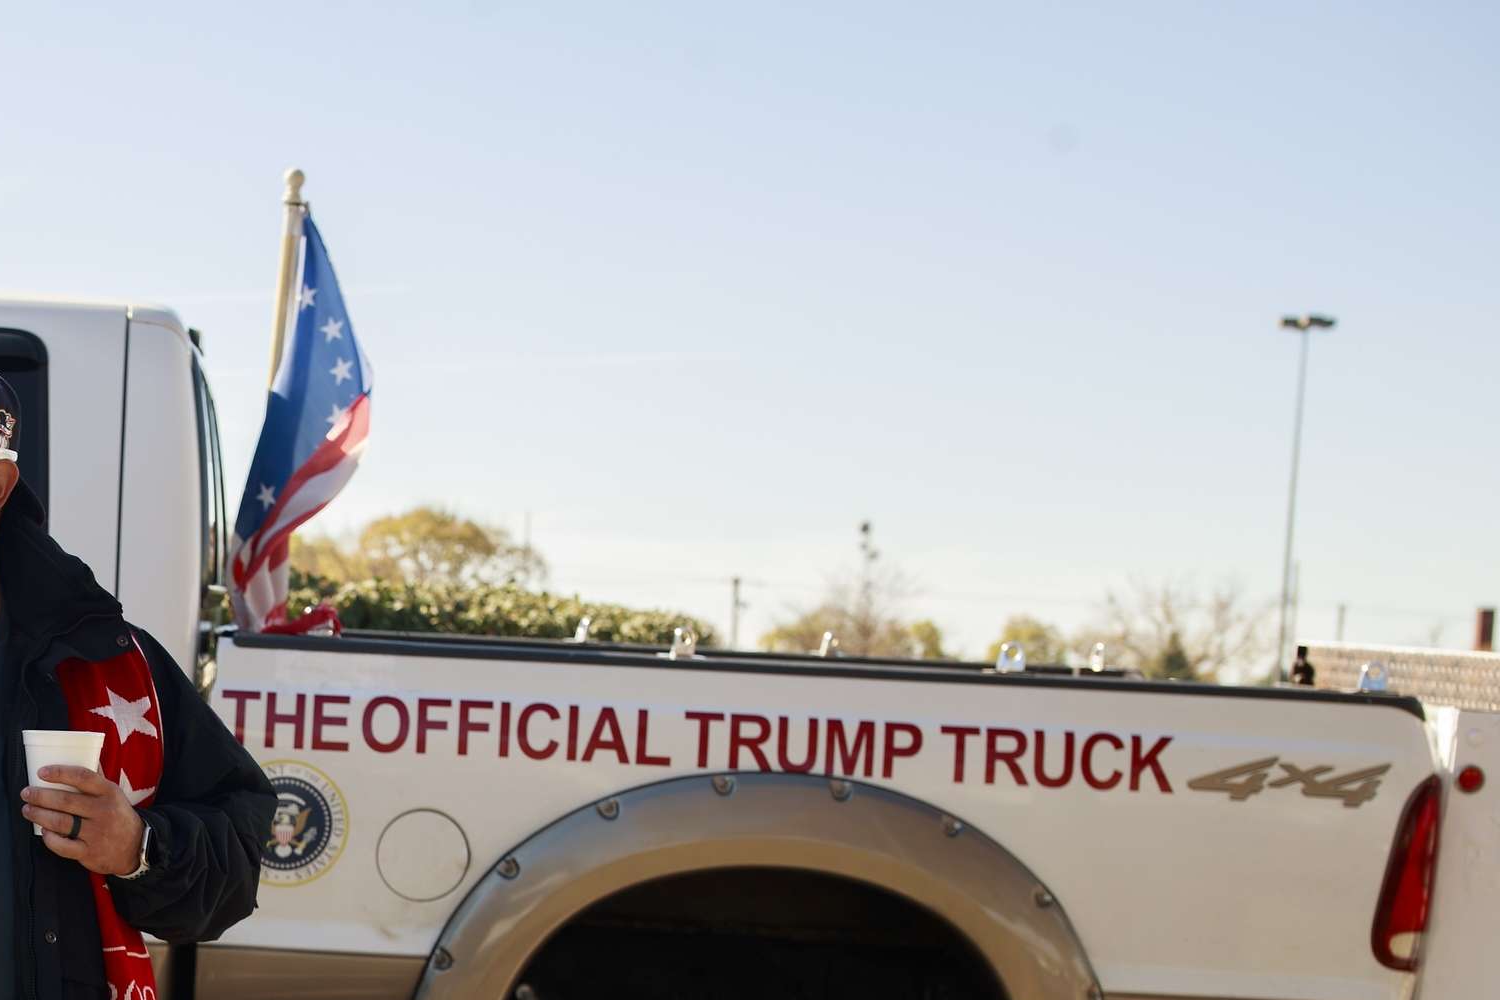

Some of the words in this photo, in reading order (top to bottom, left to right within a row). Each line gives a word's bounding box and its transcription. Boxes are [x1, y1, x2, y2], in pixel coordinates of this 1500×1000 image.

[222, 690, 350, 752] THE
[361, 696, 670, 767] OFFICIAL
[685, 711, 923, 779] TRUMP
[941, 725, 1175, 794] TRUCK
